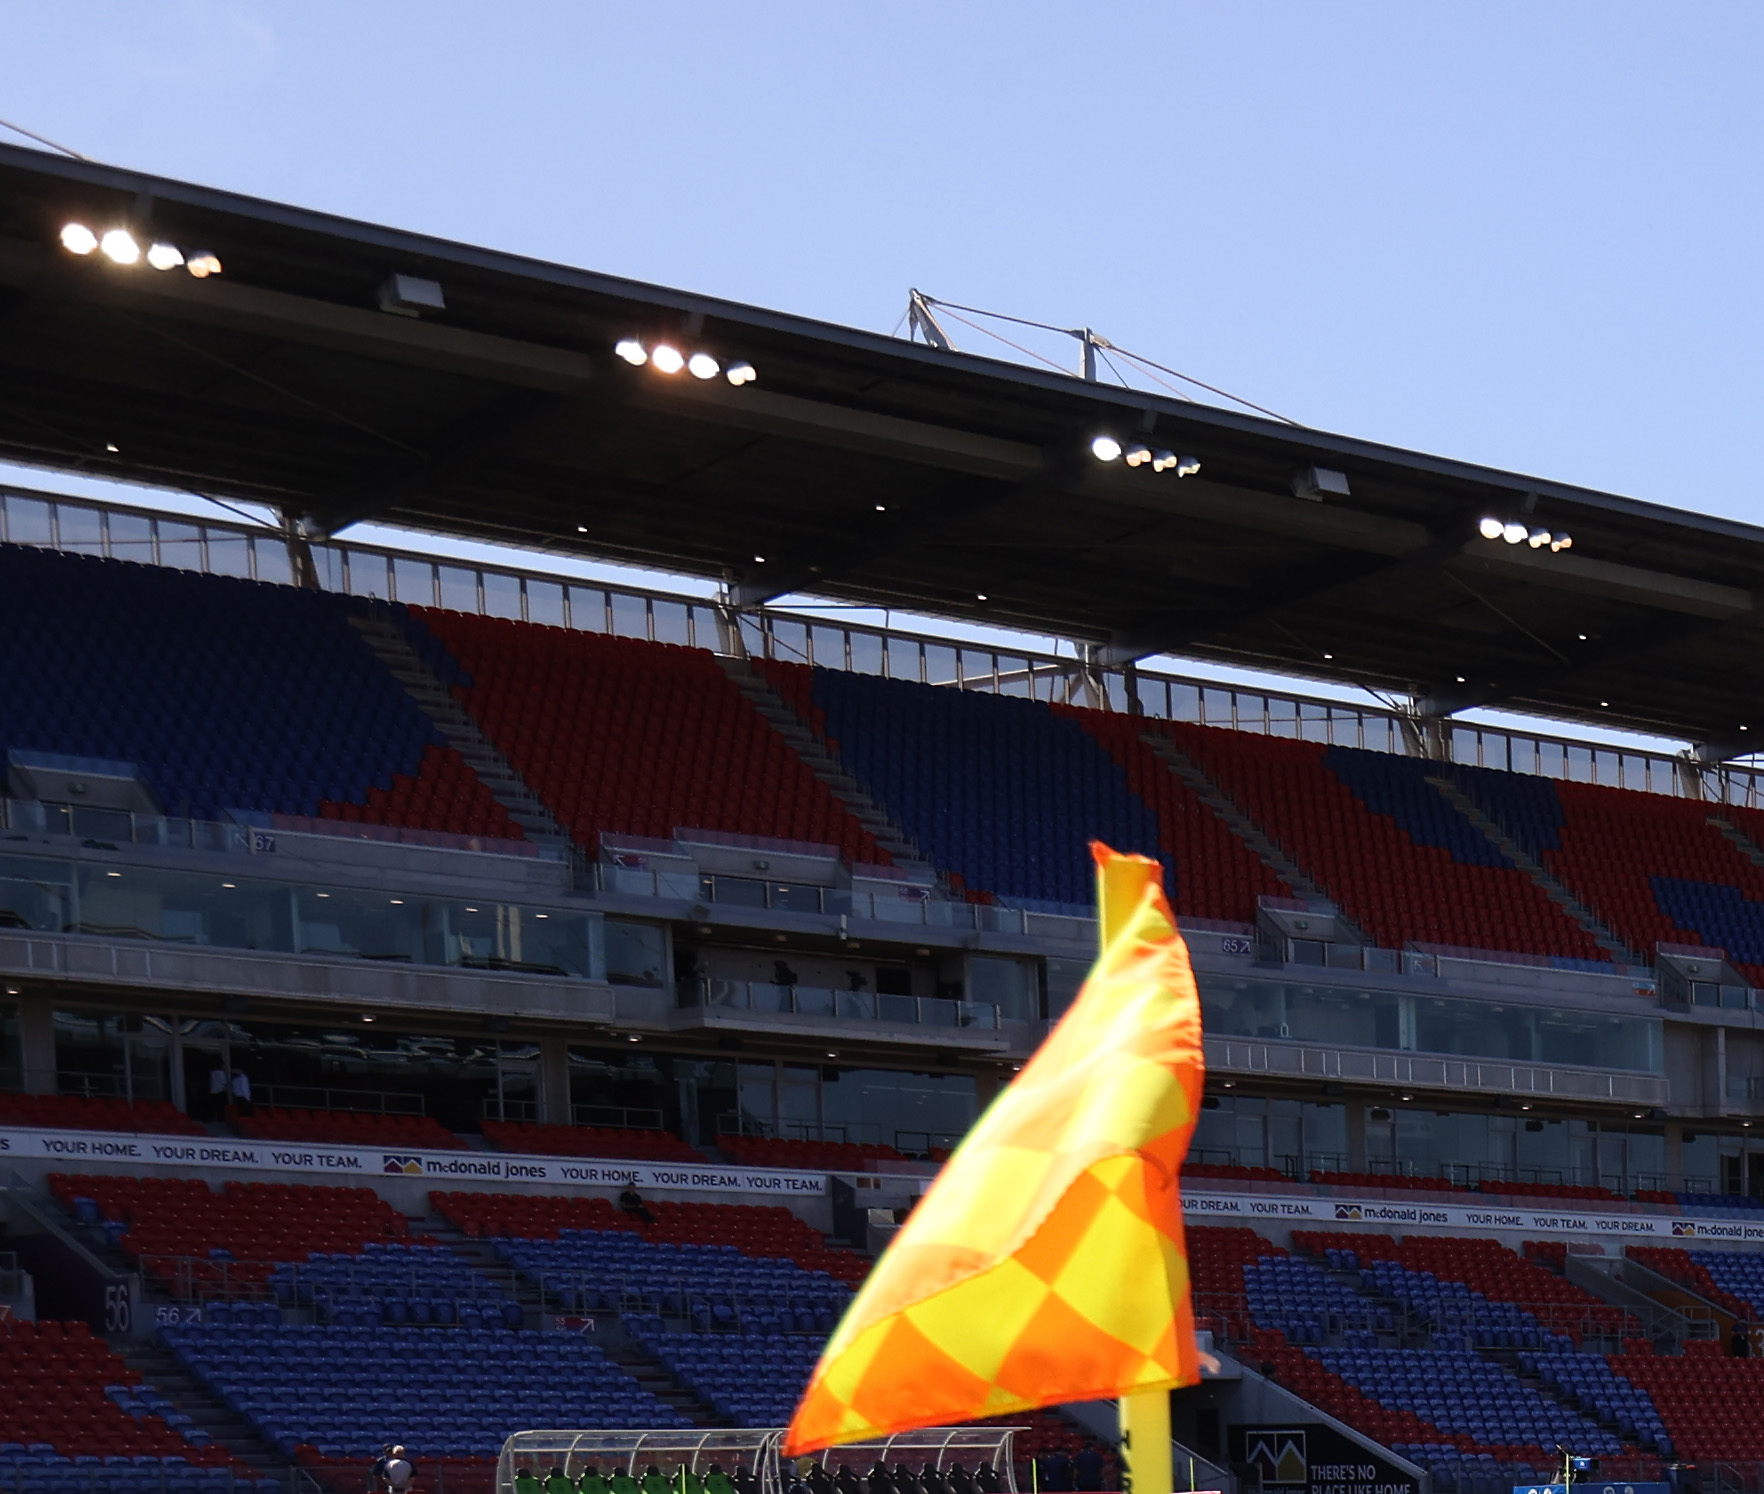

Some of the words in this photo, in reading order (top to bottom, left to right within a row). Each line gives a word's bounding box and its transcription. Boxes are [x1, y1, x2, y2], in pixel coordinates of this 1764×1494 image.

[255, 835, 274, 850] 67
[1223, 940, 1238, 952] 65
[43, 1139, 90, 1154] YOUR
[91, 1142, 141, 1157] HOME.
[152, 1145, 196, 1160] YOUR
[200, 1148, 259, 1164] DREAM.
[271, 1152, 314, 1166] YOUR
[317, 1155, 362, 1169] TEAM.
[503, 1163, 546, 1180] jones
[561, 1167, 598, 1180] YOUR
[601, 1169, 643, 1183] HOME.
[652, 1172, 689, 1185] YOUR
[692, 1174, 741, 1187] DREAM.
[746, 1176, 781, 1189] YOUR
[783, 1178, 823, 1191] TEAM.
[1200, 1202, 1241, 1213] DREAM.
[1250, 1203, 1278, 1214] YOUR
[1281, 1205, 1312, 1216] TEAM.
[1418, 1210, 1448, 1223] jones
[1466, 1213, 1494, 1225] YOUR
[1495, 1215, 1524, 1226] HOME.
[1534, 1217, 1558, 1228] YOUR
[1560, 1218, 1588, 1230] TEAM.
[1595, 1220, 1620, 1231] YOUR
[1621, 1221, 1655, 1232] DREAM.
[105, 1284, 130, 1332] 56
[156, 1307, 180, 1323] 56
[1311, 1465, 1354, 1480] THERE'S
[1358, 1465, 1376, 1480] NO
